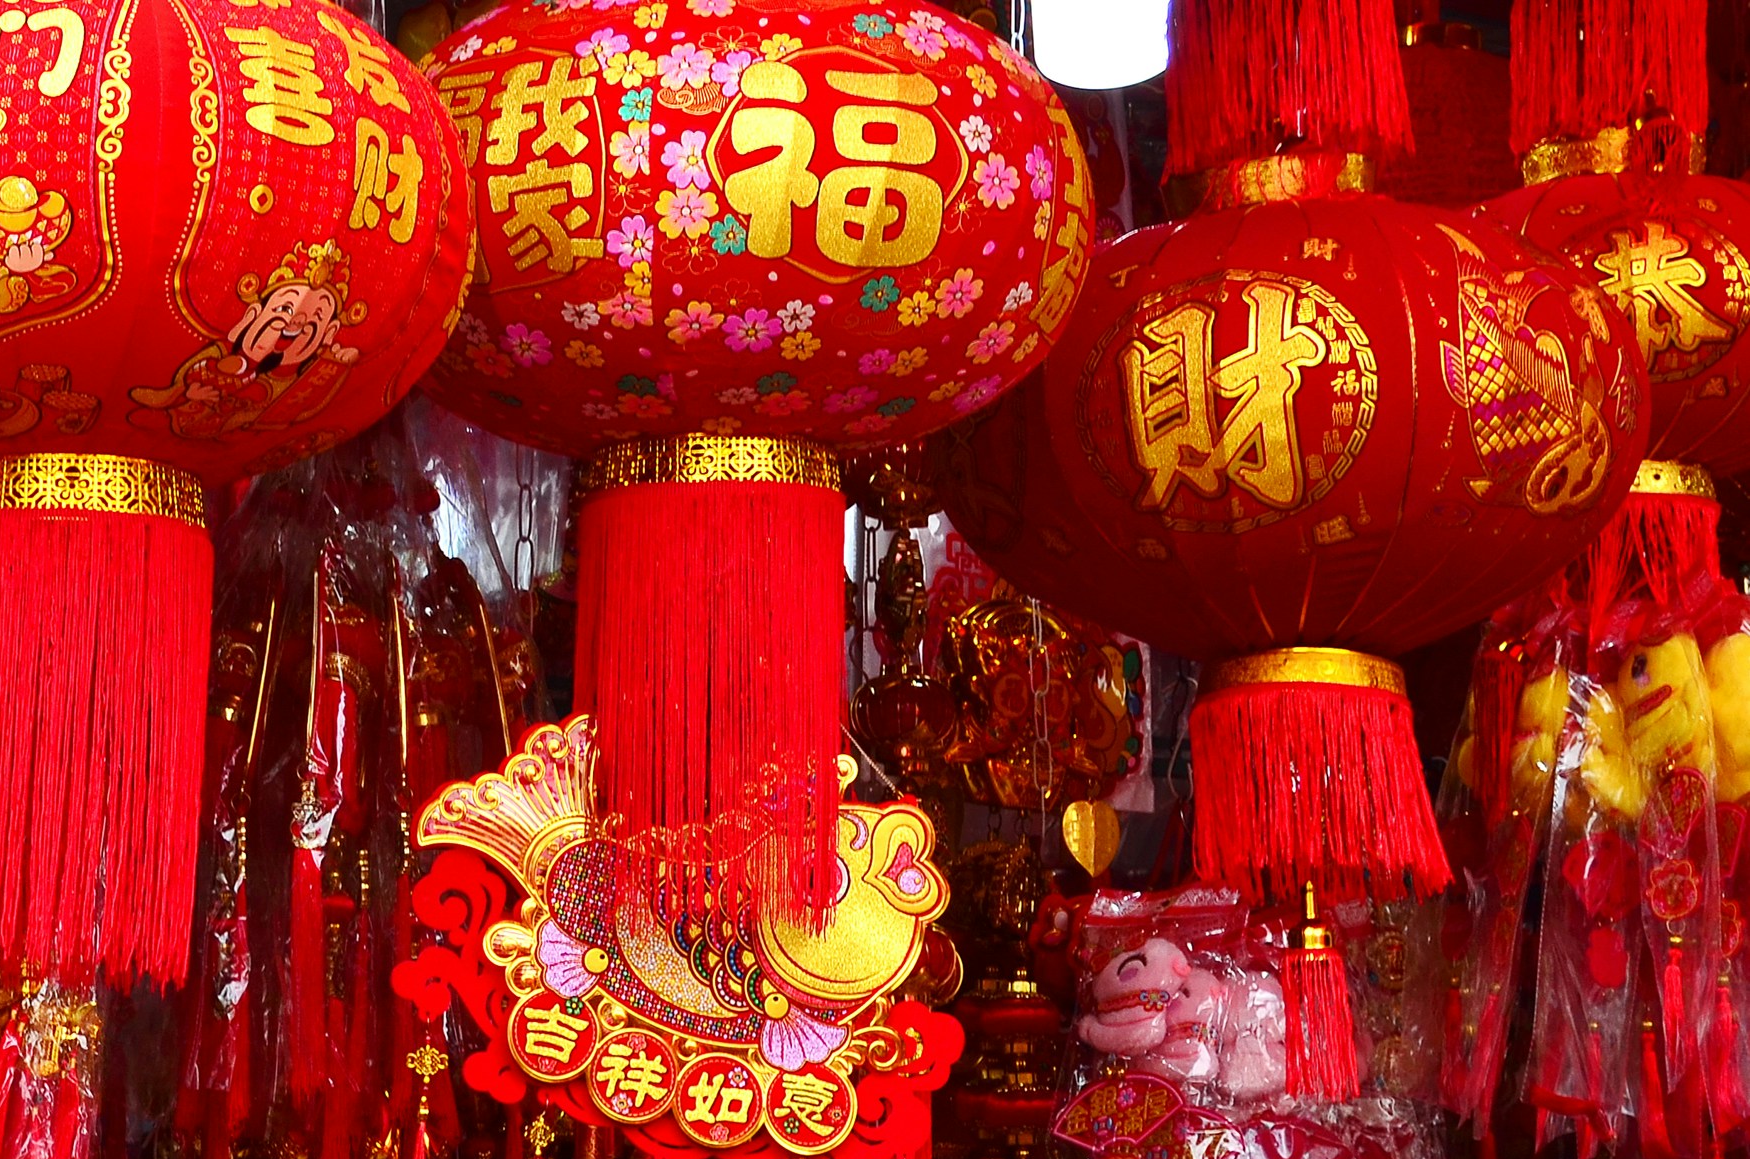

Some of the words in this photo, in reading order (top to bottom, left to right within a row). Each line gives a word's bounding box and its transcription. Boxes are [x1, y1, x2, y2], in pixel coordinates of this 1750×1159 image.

[224, 25, 336, 146] 喜
[315, 10, 425, 244] 发财
[486, 56, 604, 273] 我家
[724, 61, 943, 268] 福
[1118, 280, 1326, 511] 財
[523, 1002, 839, 1137] 吉祥如意
